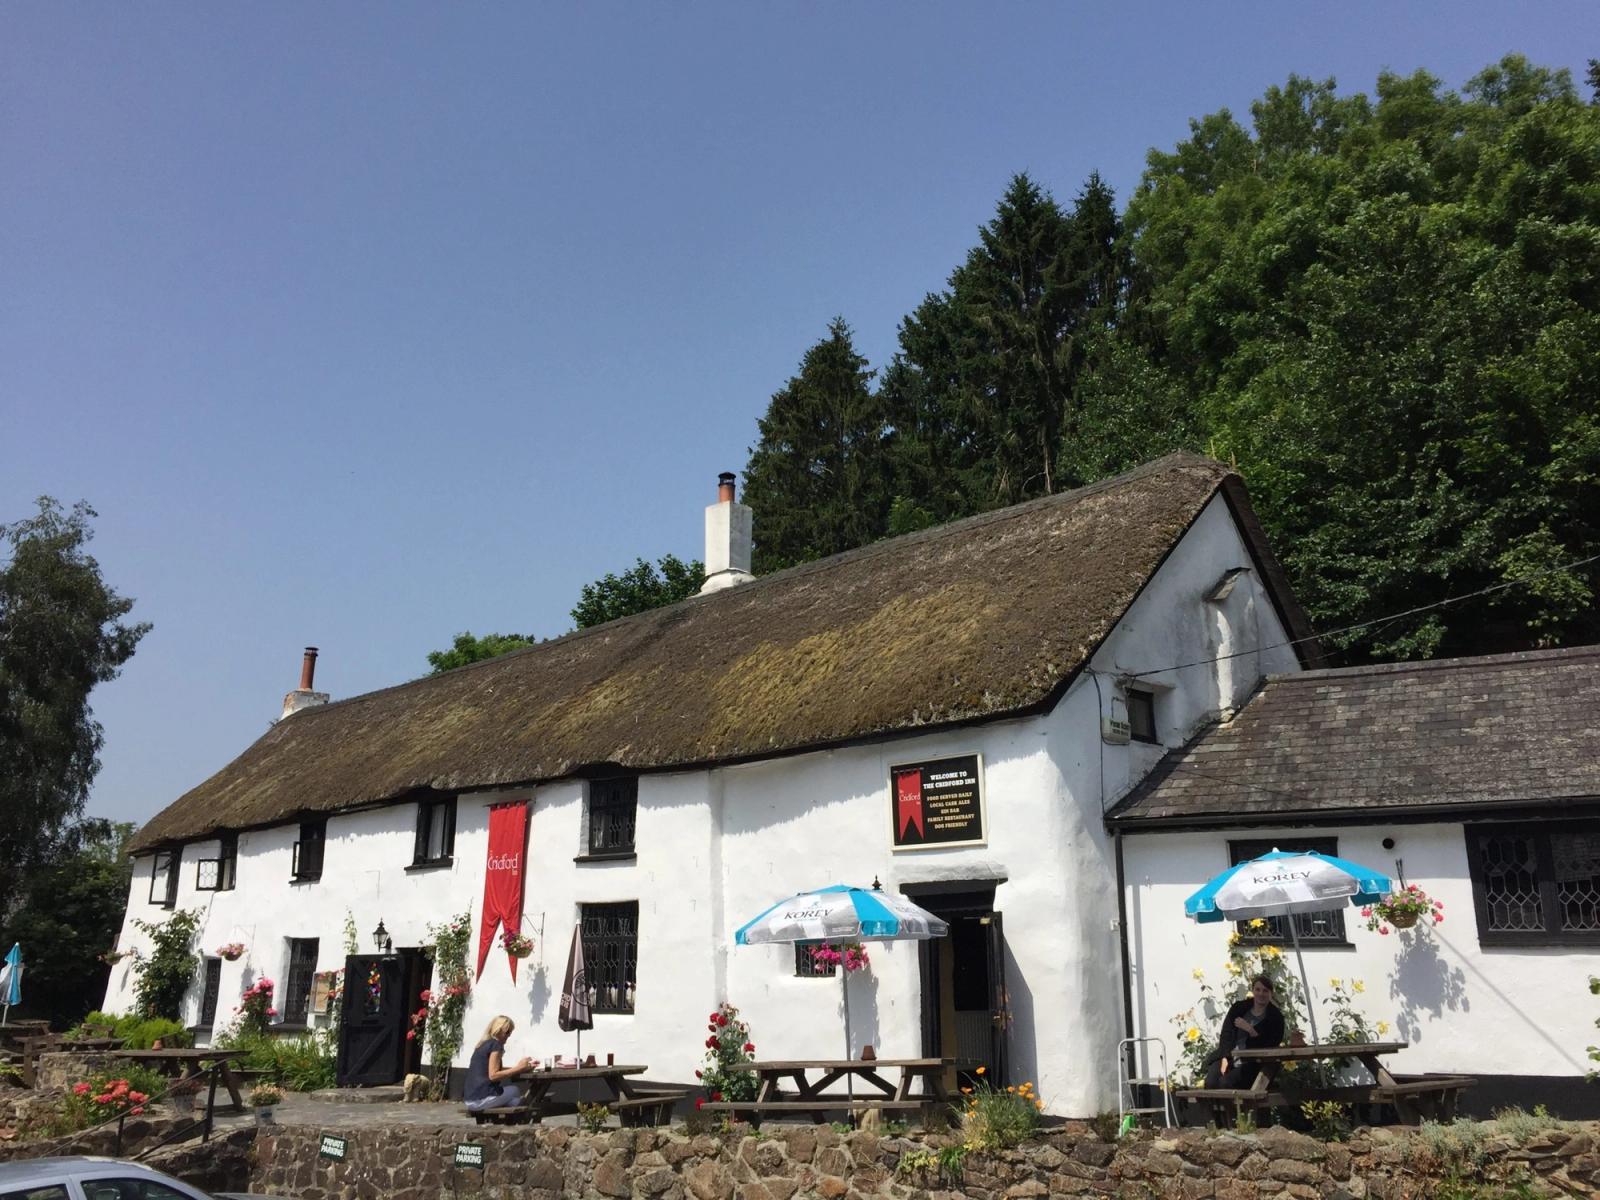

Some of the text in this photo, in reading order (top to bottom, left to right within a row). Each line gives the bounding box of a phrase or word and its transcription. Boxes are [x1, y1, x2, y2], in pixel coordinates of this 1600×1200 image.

[930, 772, 958, 780] WELCOME
[935, 780, 964, 788] CRIDFORD
[1253, 871, 1311, 884] KOREV
[784, 908, 834, 920] KOREV
[323, 1137, 345, 1149] PRIVATE
[320, 1145, 344, 1157] PARKING
[457, 1145, 482, 1155] PRIVATE
[455, 1154, 482, 1164] PARKING
